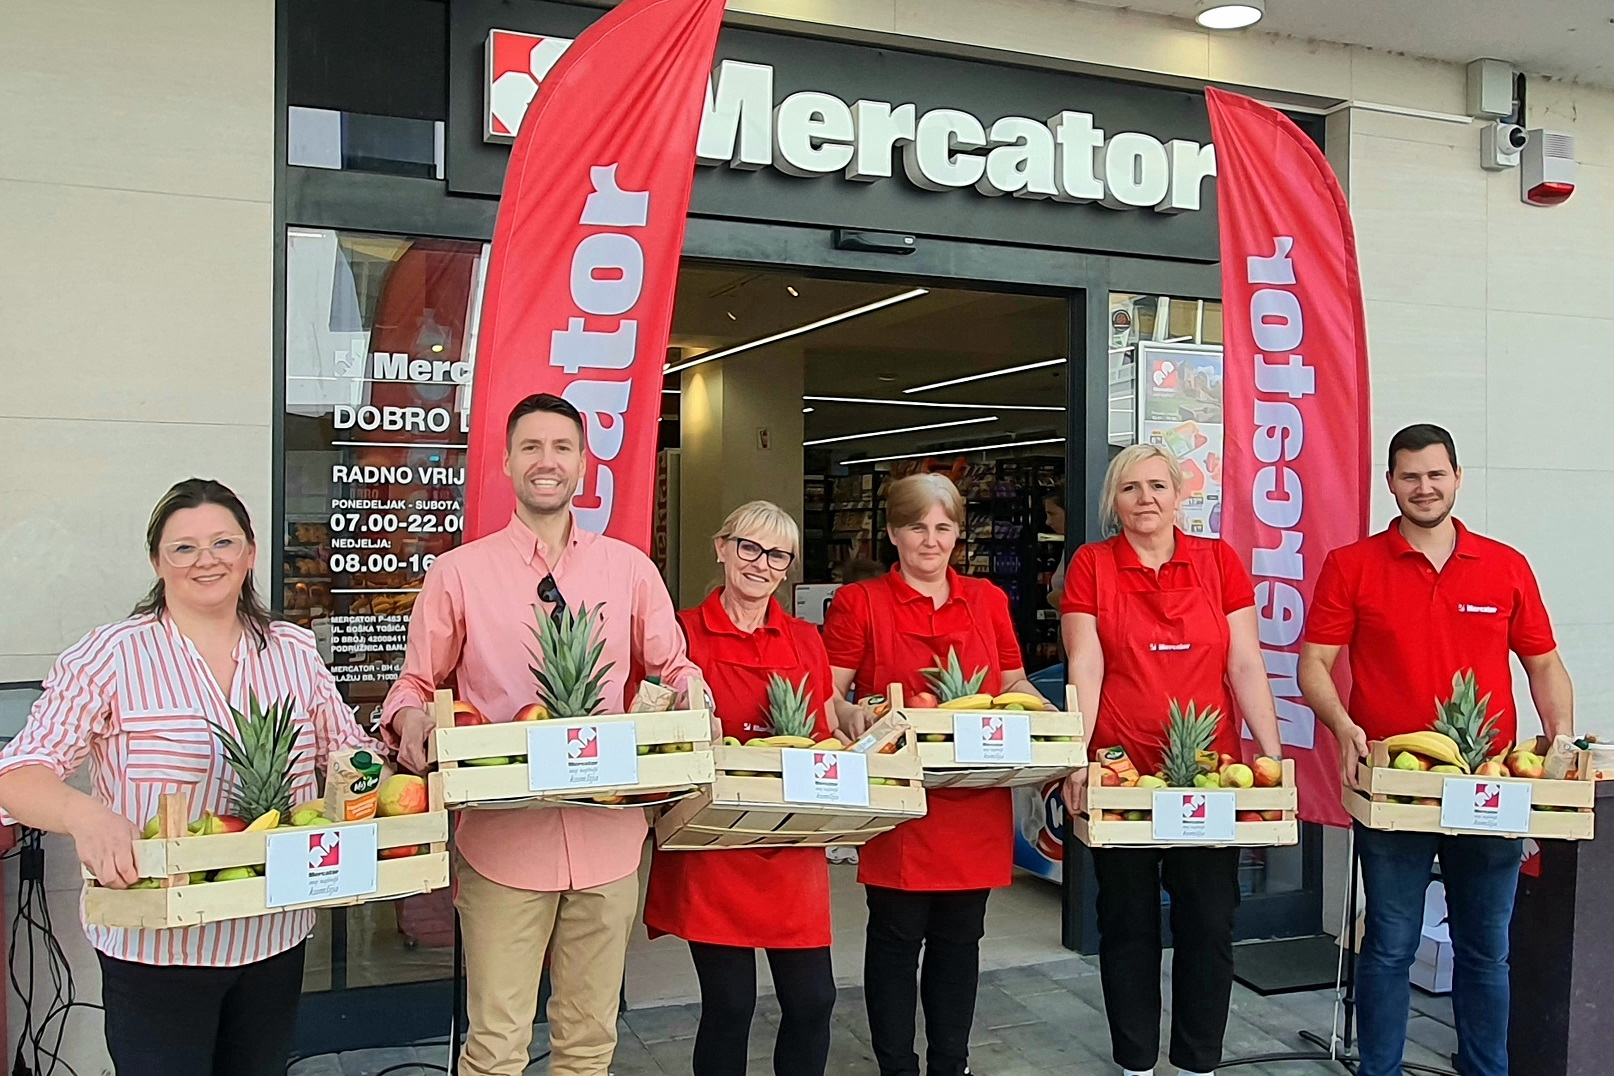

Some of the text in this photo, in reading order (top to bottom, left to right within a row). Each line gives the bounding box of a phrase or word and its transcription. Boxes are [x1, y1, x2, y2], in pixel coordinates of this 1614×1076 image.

[695, 59, 1217, 212] Mercator
[333, 404, 451, 432] DOBRO
[332, 465, 465, 485] RADNO VRIJ
[331, 499, 406, 509] PONEDELJAK
[415, 500, 460, 510] SUBOTA
[331, 538, 392, 549] NEDJELJA:
[330, 615, 376, 623] MERCATOR
[330, 664, 375, 673] MERCATOR
